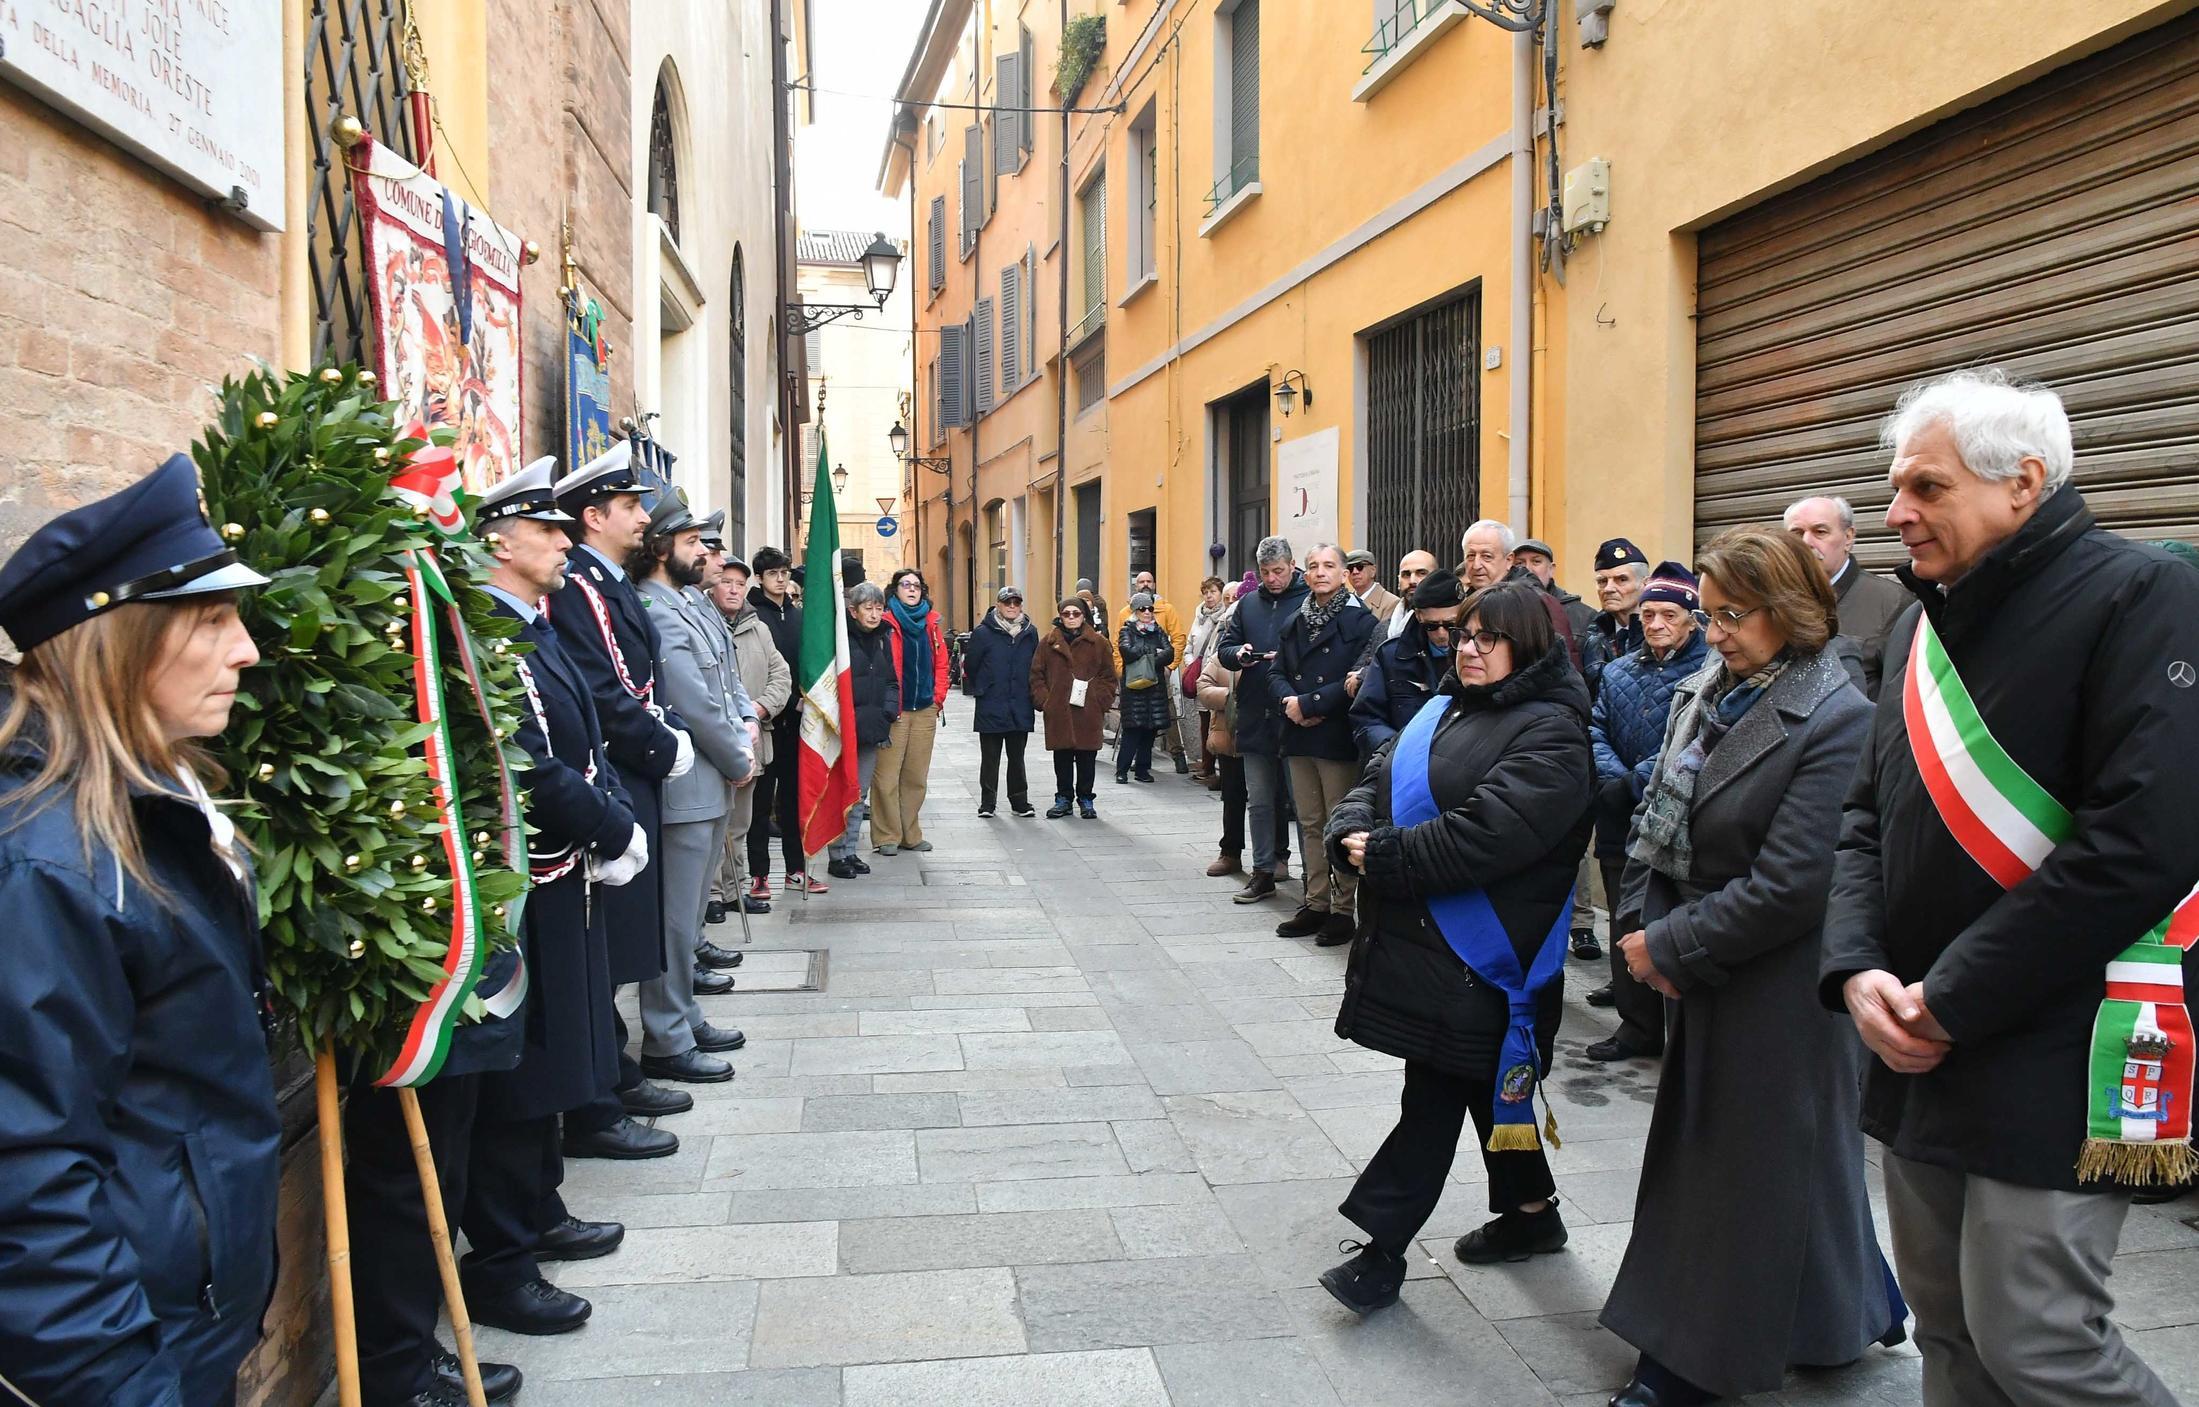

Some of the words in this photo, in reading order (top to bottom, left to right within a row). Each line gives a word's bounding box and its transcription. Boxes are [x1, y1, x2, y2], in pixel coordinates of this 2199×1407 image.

[142, 7, 182, 62] JOLE
[32, 20, 80, 71] DELLA
[92, 60, 153, 119] MEMORIA
[188, 126, 235, 171] GENNAIO
[150, 48, 213, 117] ORESTE
[384, 178, 432, 224] COMUNE
[434, 208, 444, 230] D
[2125, 1089, 2133, 1101] Q
[2144, 1090, 2152, 1101] R
[2128, 1065, 2136, 1074] S
[2147, 1067, 2156, 1077] P
